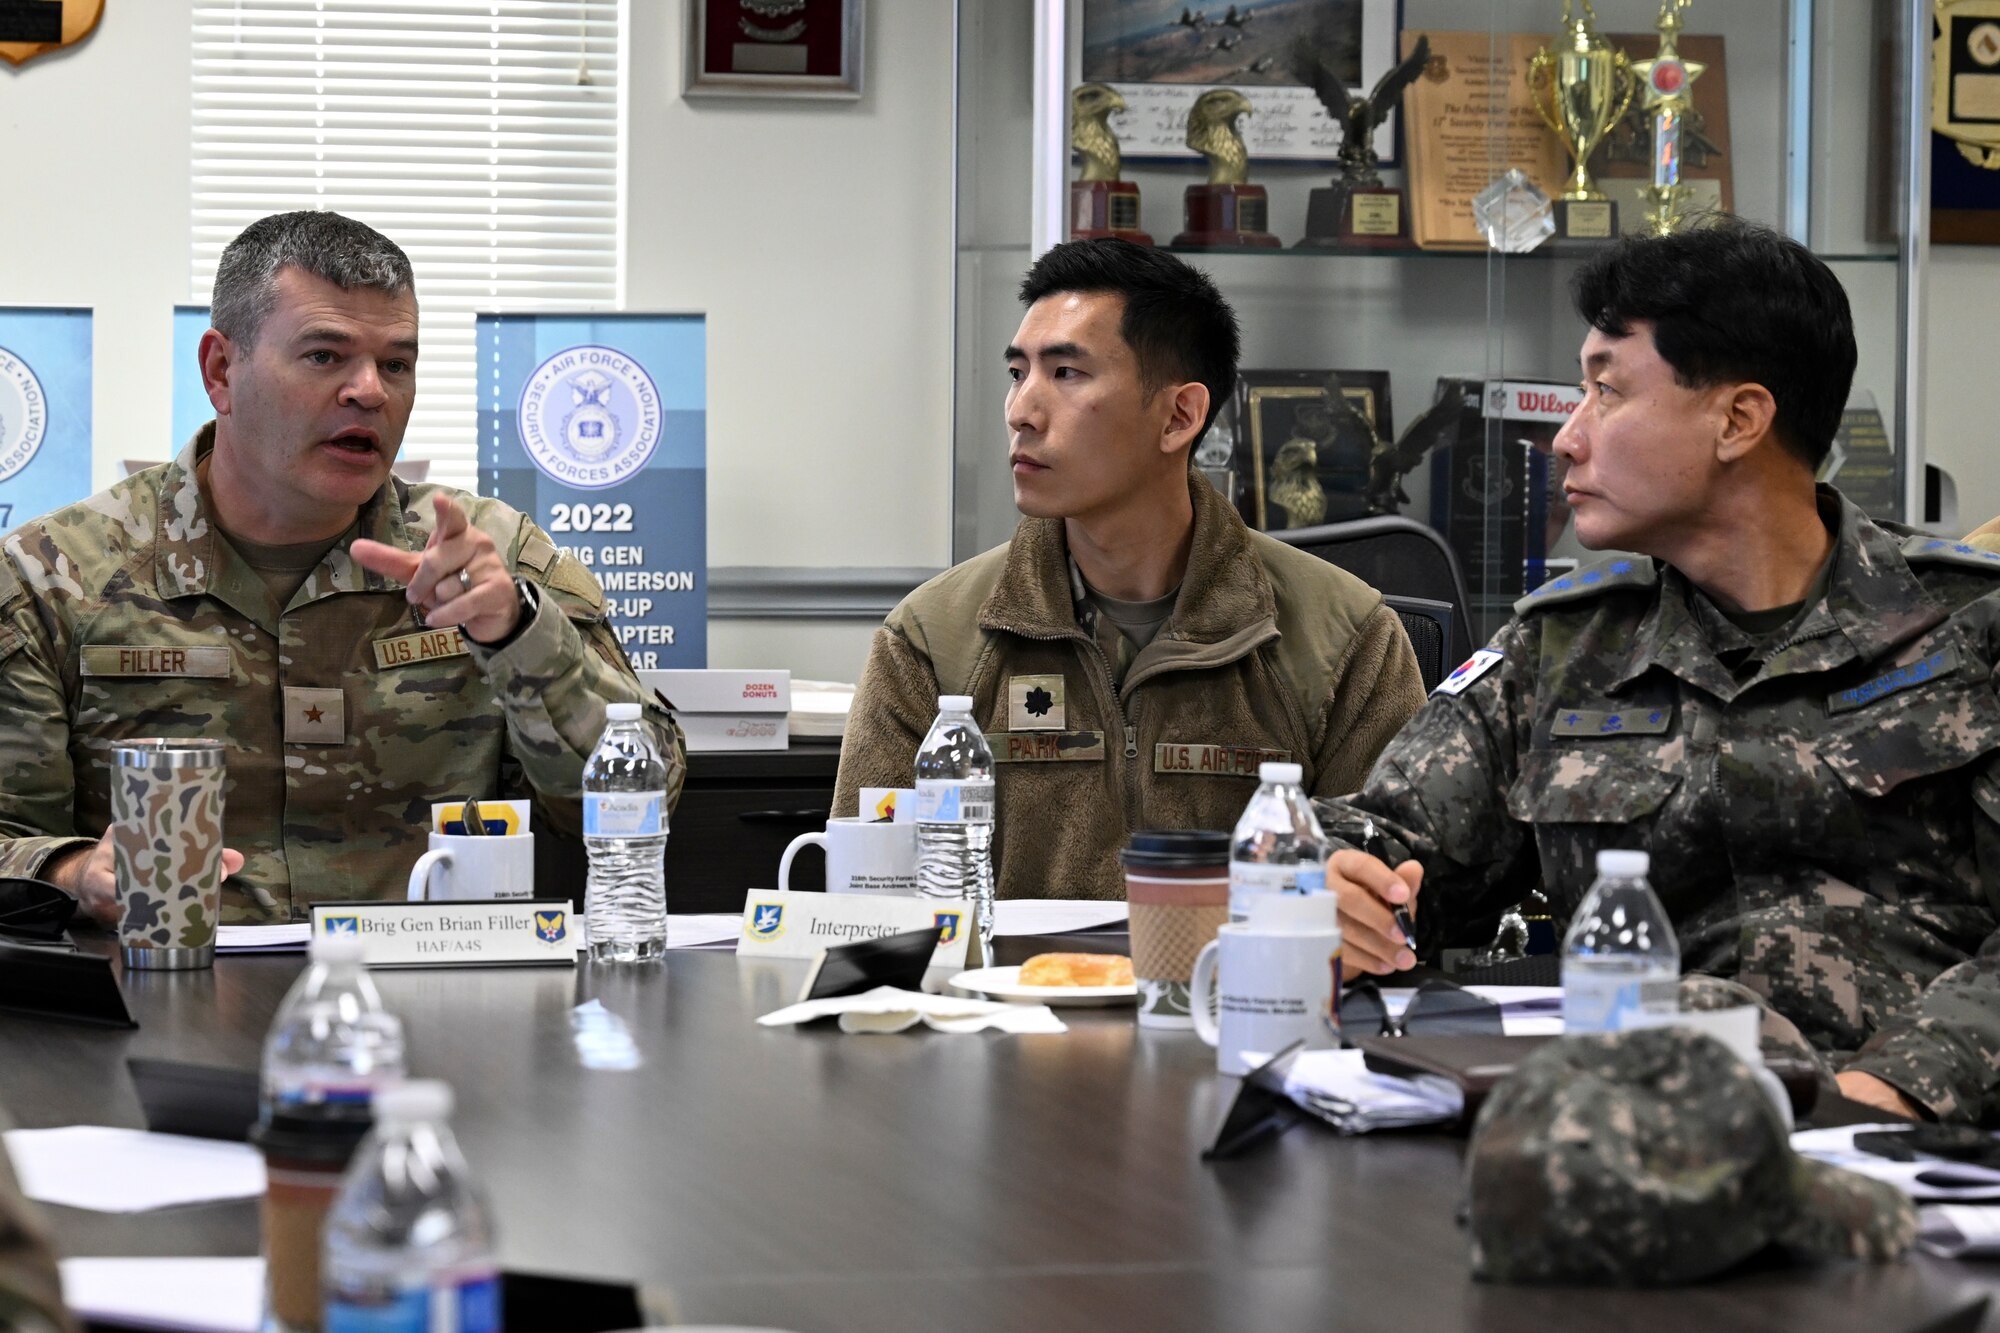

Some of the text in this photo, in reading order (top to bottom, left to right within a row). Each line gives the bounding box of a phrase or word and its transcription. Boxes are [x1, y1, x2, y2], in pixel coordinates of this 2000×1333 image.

[552, 352, 632, 376] AIR FORCE
[1517, 391, 1580, 414] Wilso
[526, 381, 655, 480] SECURITY FORCES ASSOCIATION
[551, 503, 633, 532] 2022
[601, 546, 643, 566] GEN
[382, 640, 415, 665] U.S.
[420, 633, 451, 658] AIR
[119, 650, 186, 673] FILLER
[1007, 735, 1061, 760] PARK
[1162, 746, 1194, 771] U.S.
[1200, 747, 1229, 771] AIR
[361, 915, 531, 936] Brig Gen Brian Filler
[809, 917, 900, 941] Interpreter
[416, 939, 483, 953] HAF/A4S
